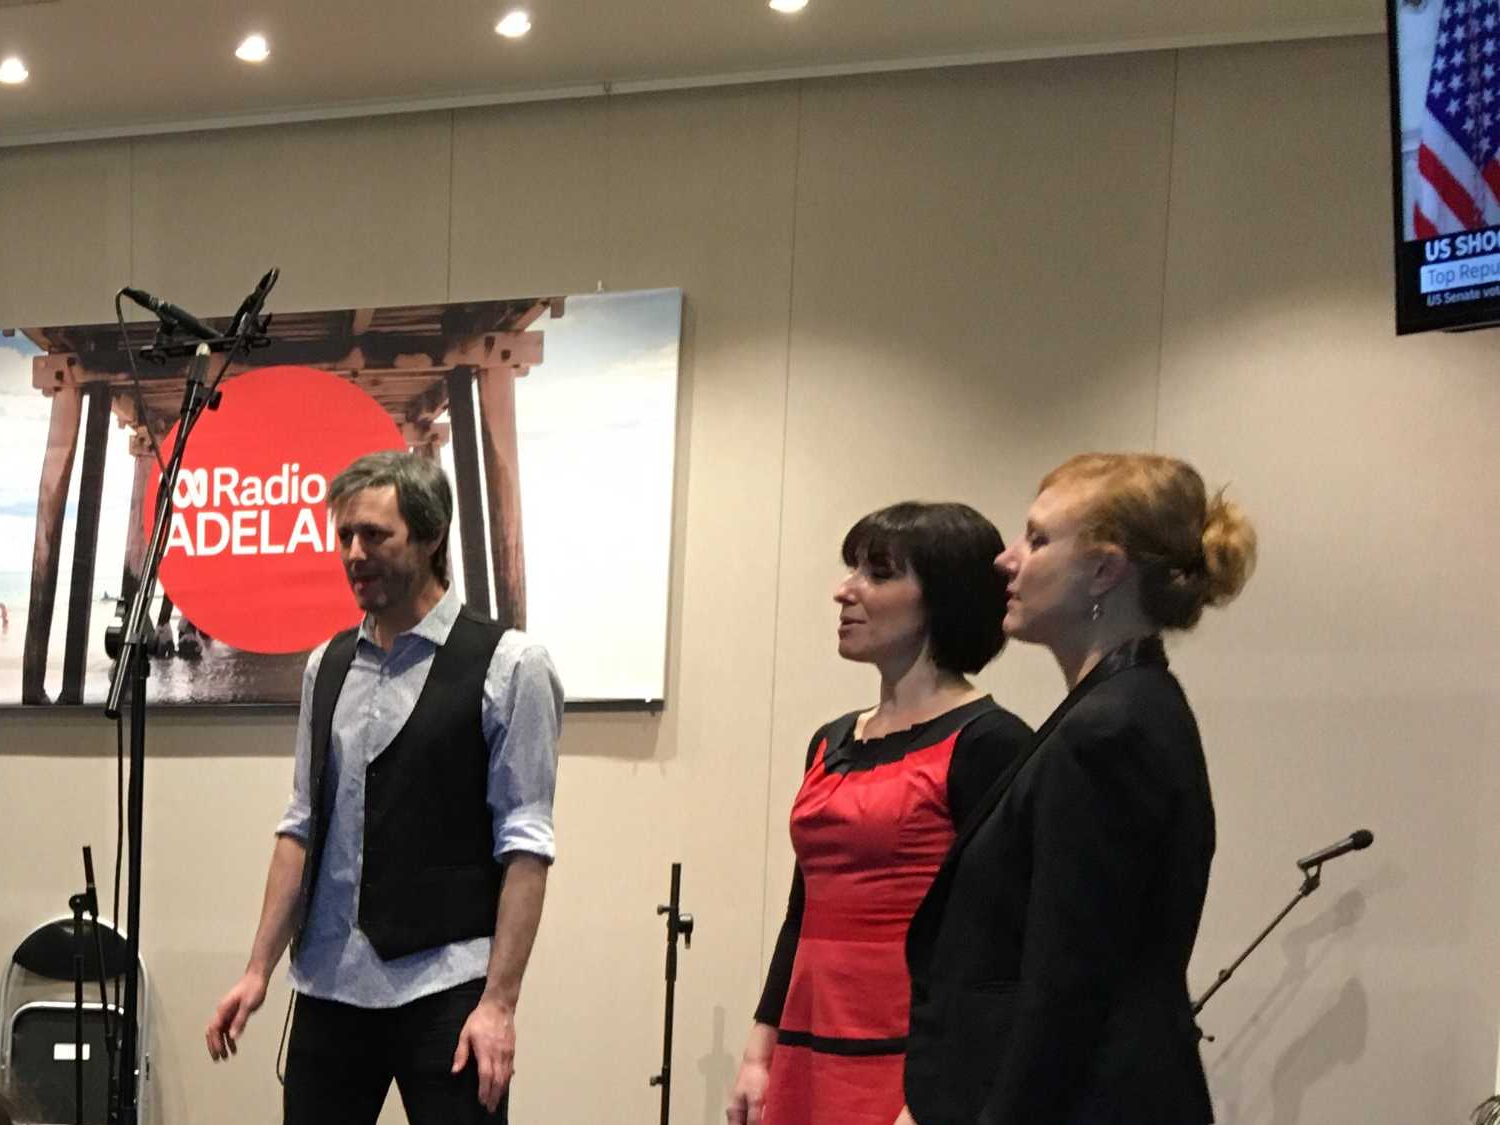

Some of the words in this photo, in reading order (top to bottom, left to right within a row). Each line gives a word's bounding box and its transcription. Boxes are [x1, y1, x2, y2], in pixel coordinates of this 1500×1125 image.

[1425, 238, 1452, 262] US
[1455, 230, 1500, 257] SHO
[1428, 269, 1455, 287] Top
[212, 463, 327, 507] Radio
[163, 508, 337, 557] ADELAI
